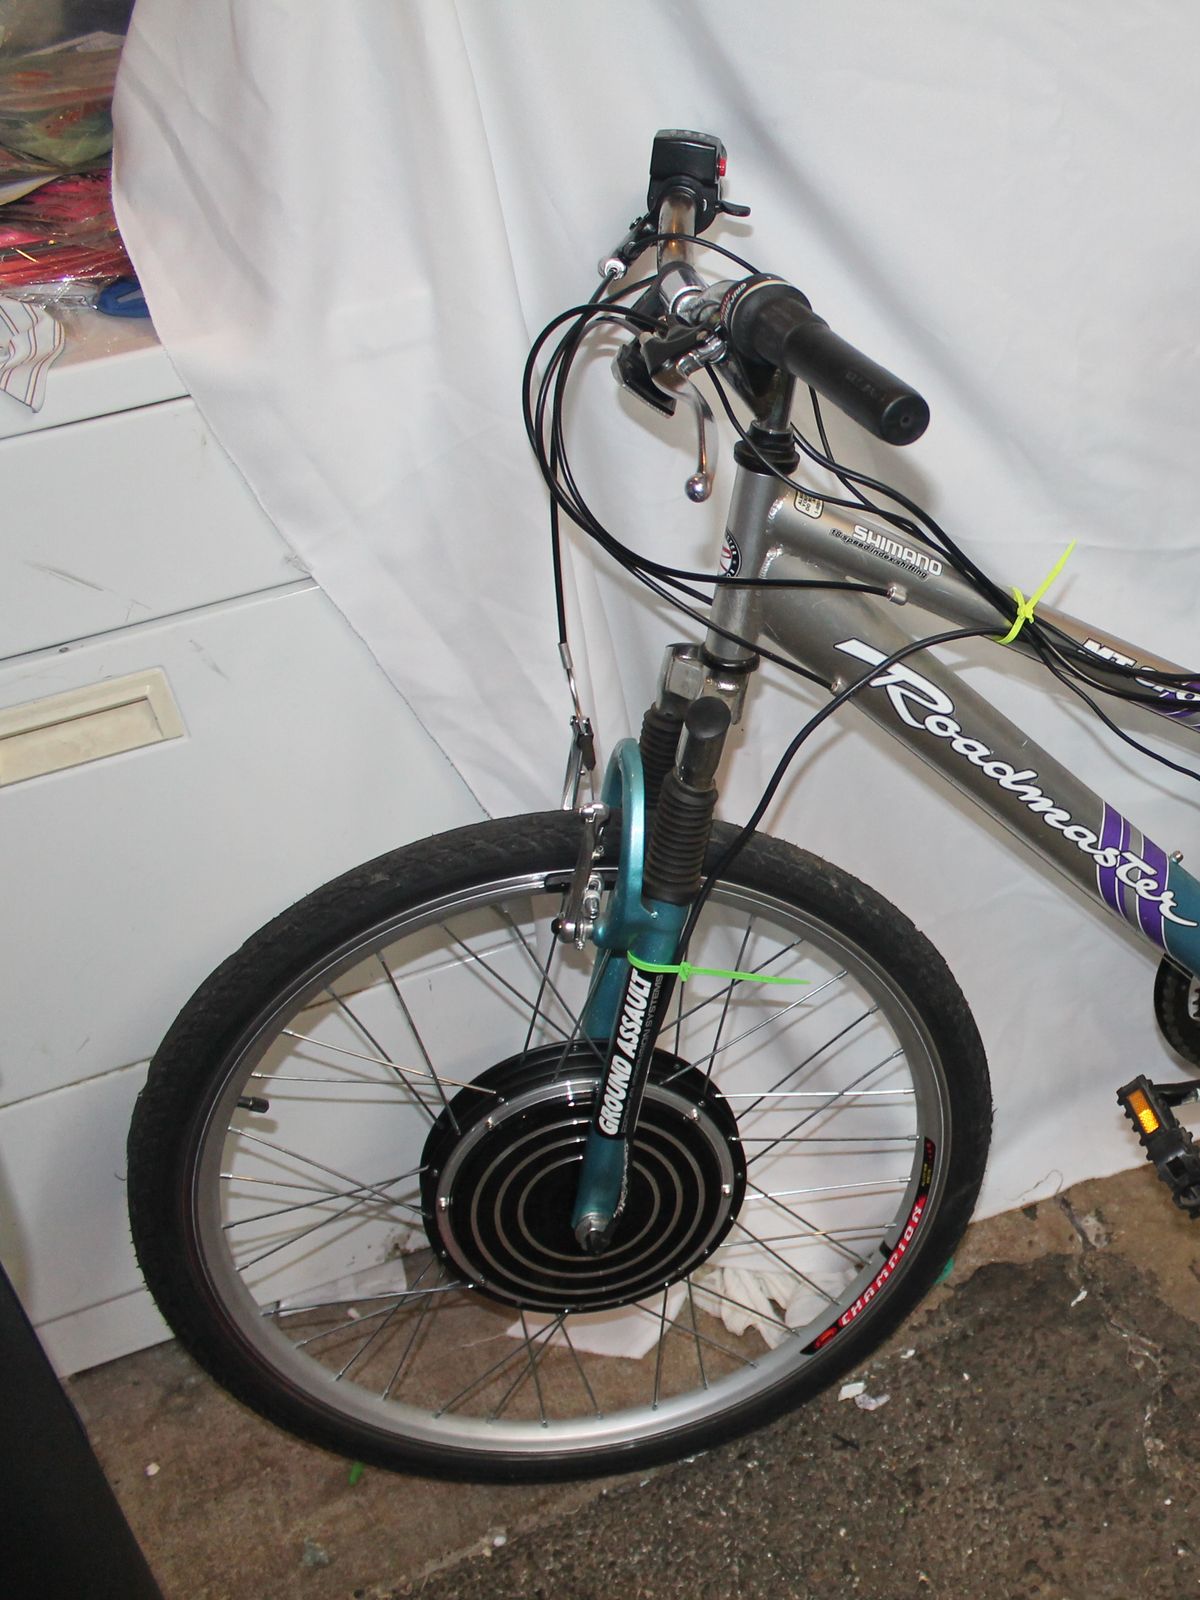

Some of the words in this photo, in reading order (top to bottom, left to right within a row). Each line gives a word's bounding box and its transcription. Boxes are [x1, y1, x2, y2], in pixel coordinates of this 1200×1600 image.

[853, 525, 942, 576] SHIMANO
[833, 637, 1199, 928] Roadmaster
[599, 1054, 633, 1136] GROUND
[616, 967, 652, 1060] ASSAULT
[645, 974, 664, 1027] SYSTEMS
[838, 1205, 923, 1327] CHAMPION
